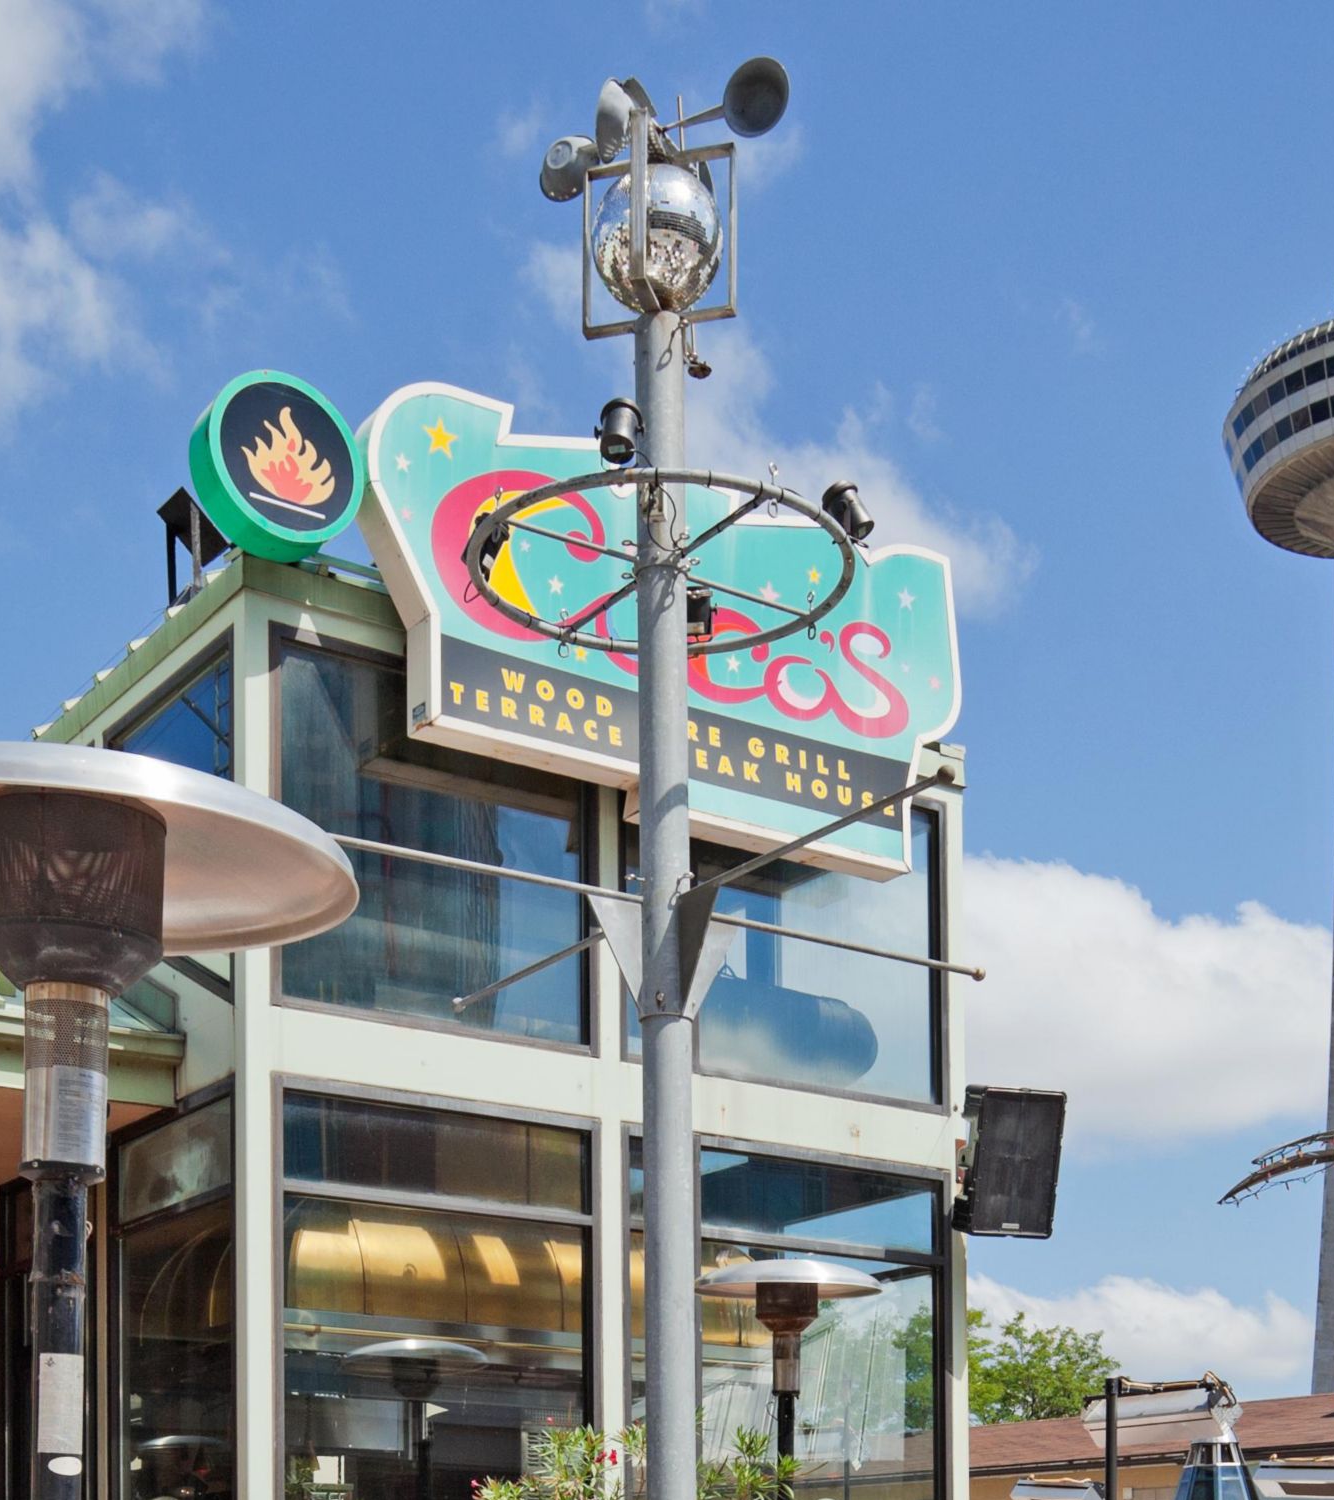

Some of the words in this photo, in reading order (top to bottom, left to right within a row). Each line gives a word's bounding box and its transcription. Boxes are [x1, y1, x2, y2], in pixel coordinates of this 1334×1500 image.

[449, 681, 623, 747] TERRACE
[695, 748, 761, 784] EAK
[501, 667, 614, 718] WOOD
[687, 720, 722, 749] RE
[748, 736, 851, 781] GRILL
